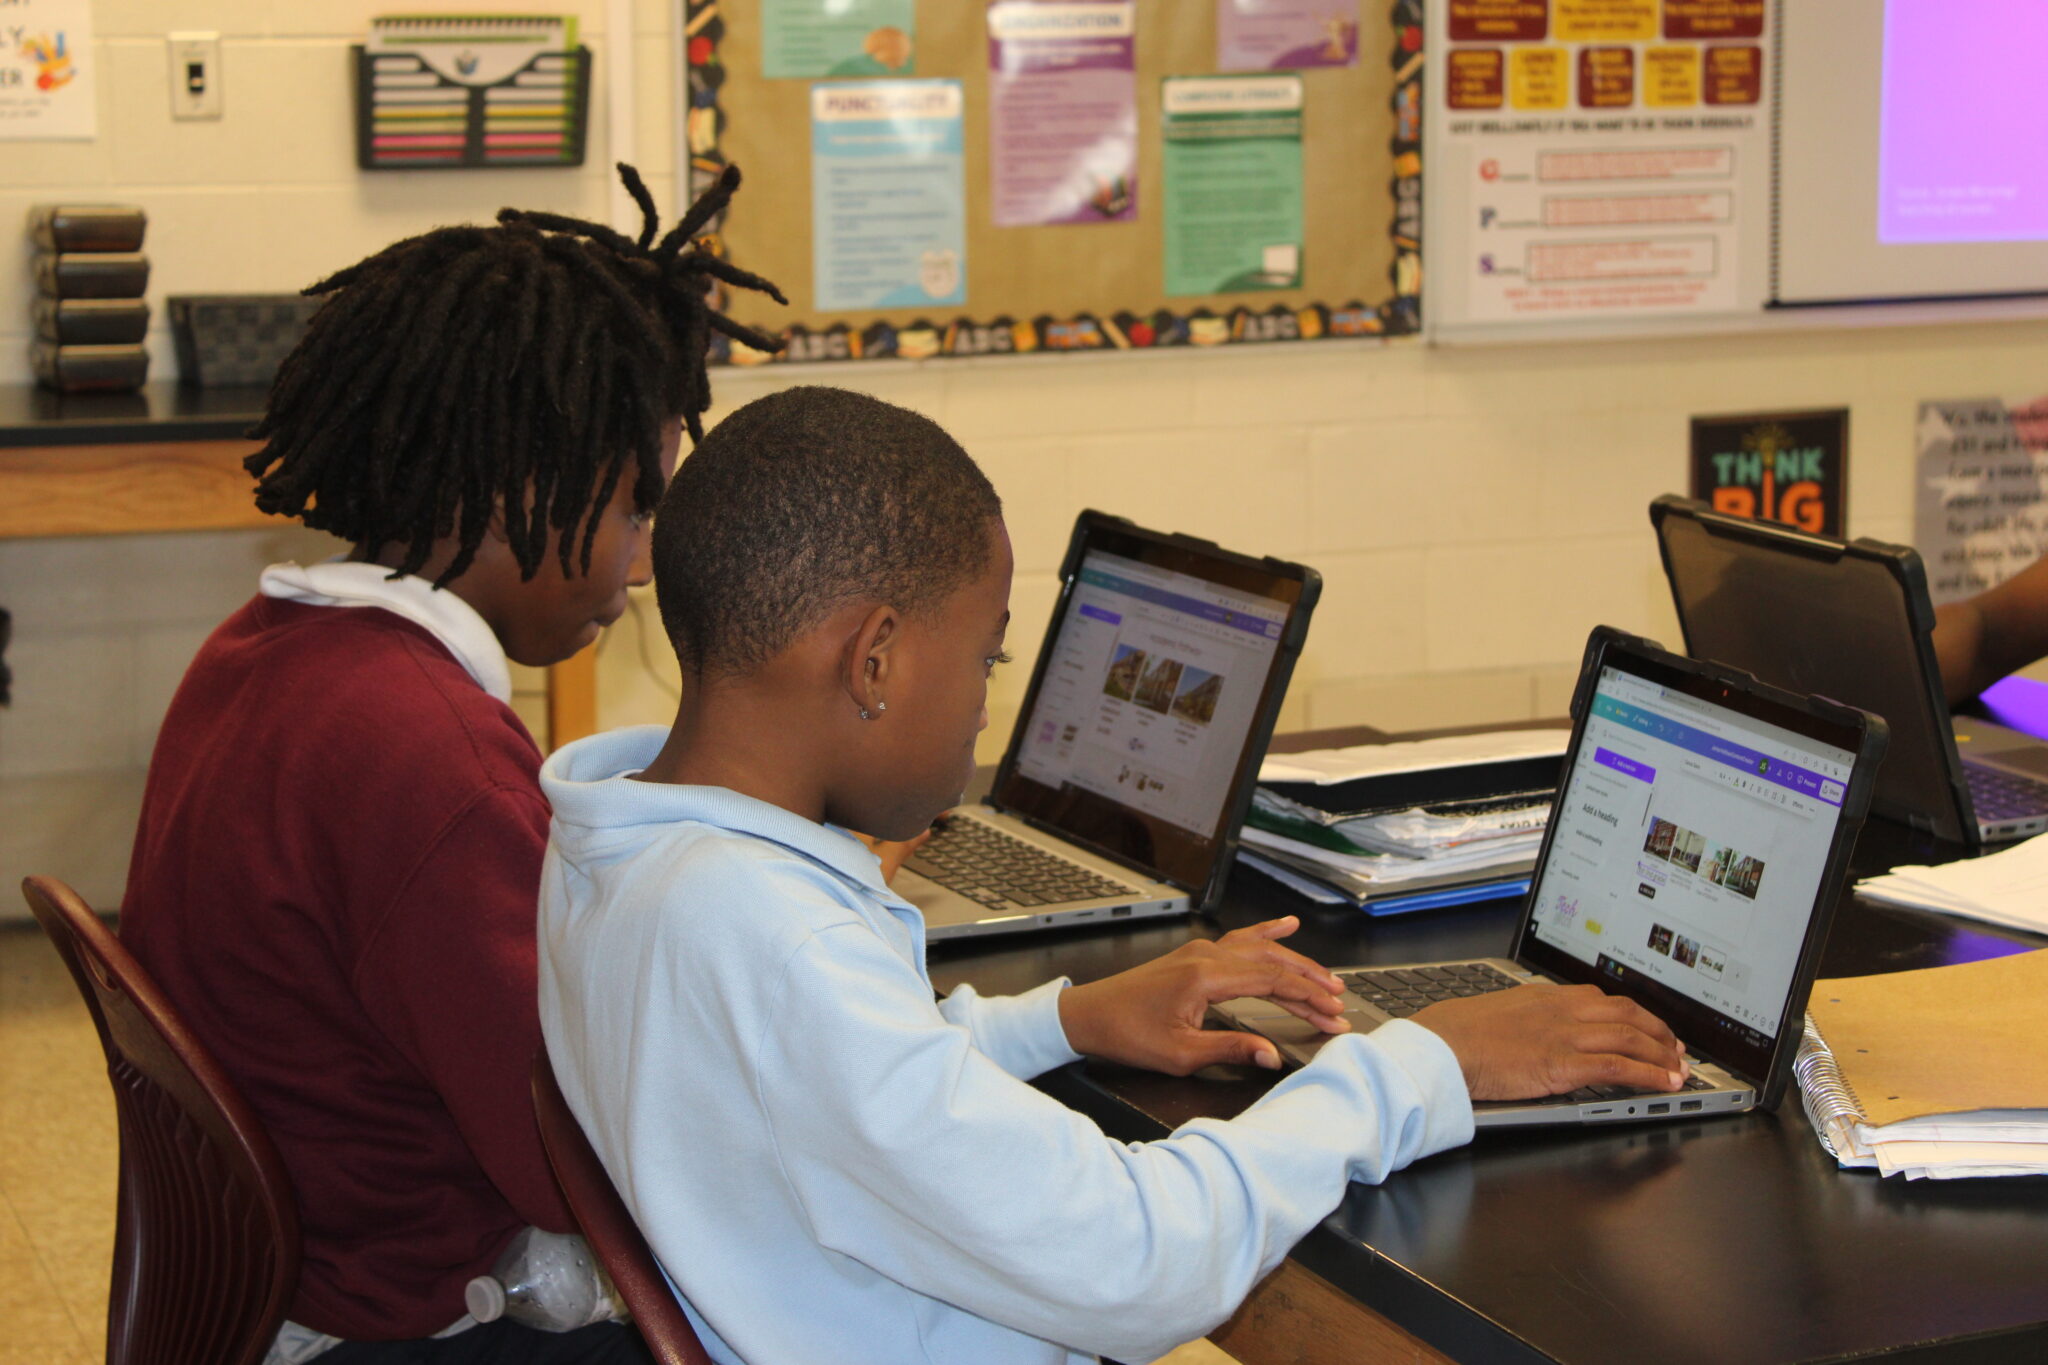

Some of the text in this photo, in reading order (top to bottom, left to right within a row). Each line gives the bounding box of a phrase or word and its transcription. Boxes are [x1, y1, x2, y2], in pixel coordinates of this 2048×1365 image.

[1712, 447, 1823, 486] THINK
[1713, 474, 1824, 534] BIG
[1582, 803, 1594, 816] Add
[1597, 809, 1619, 828] heading
